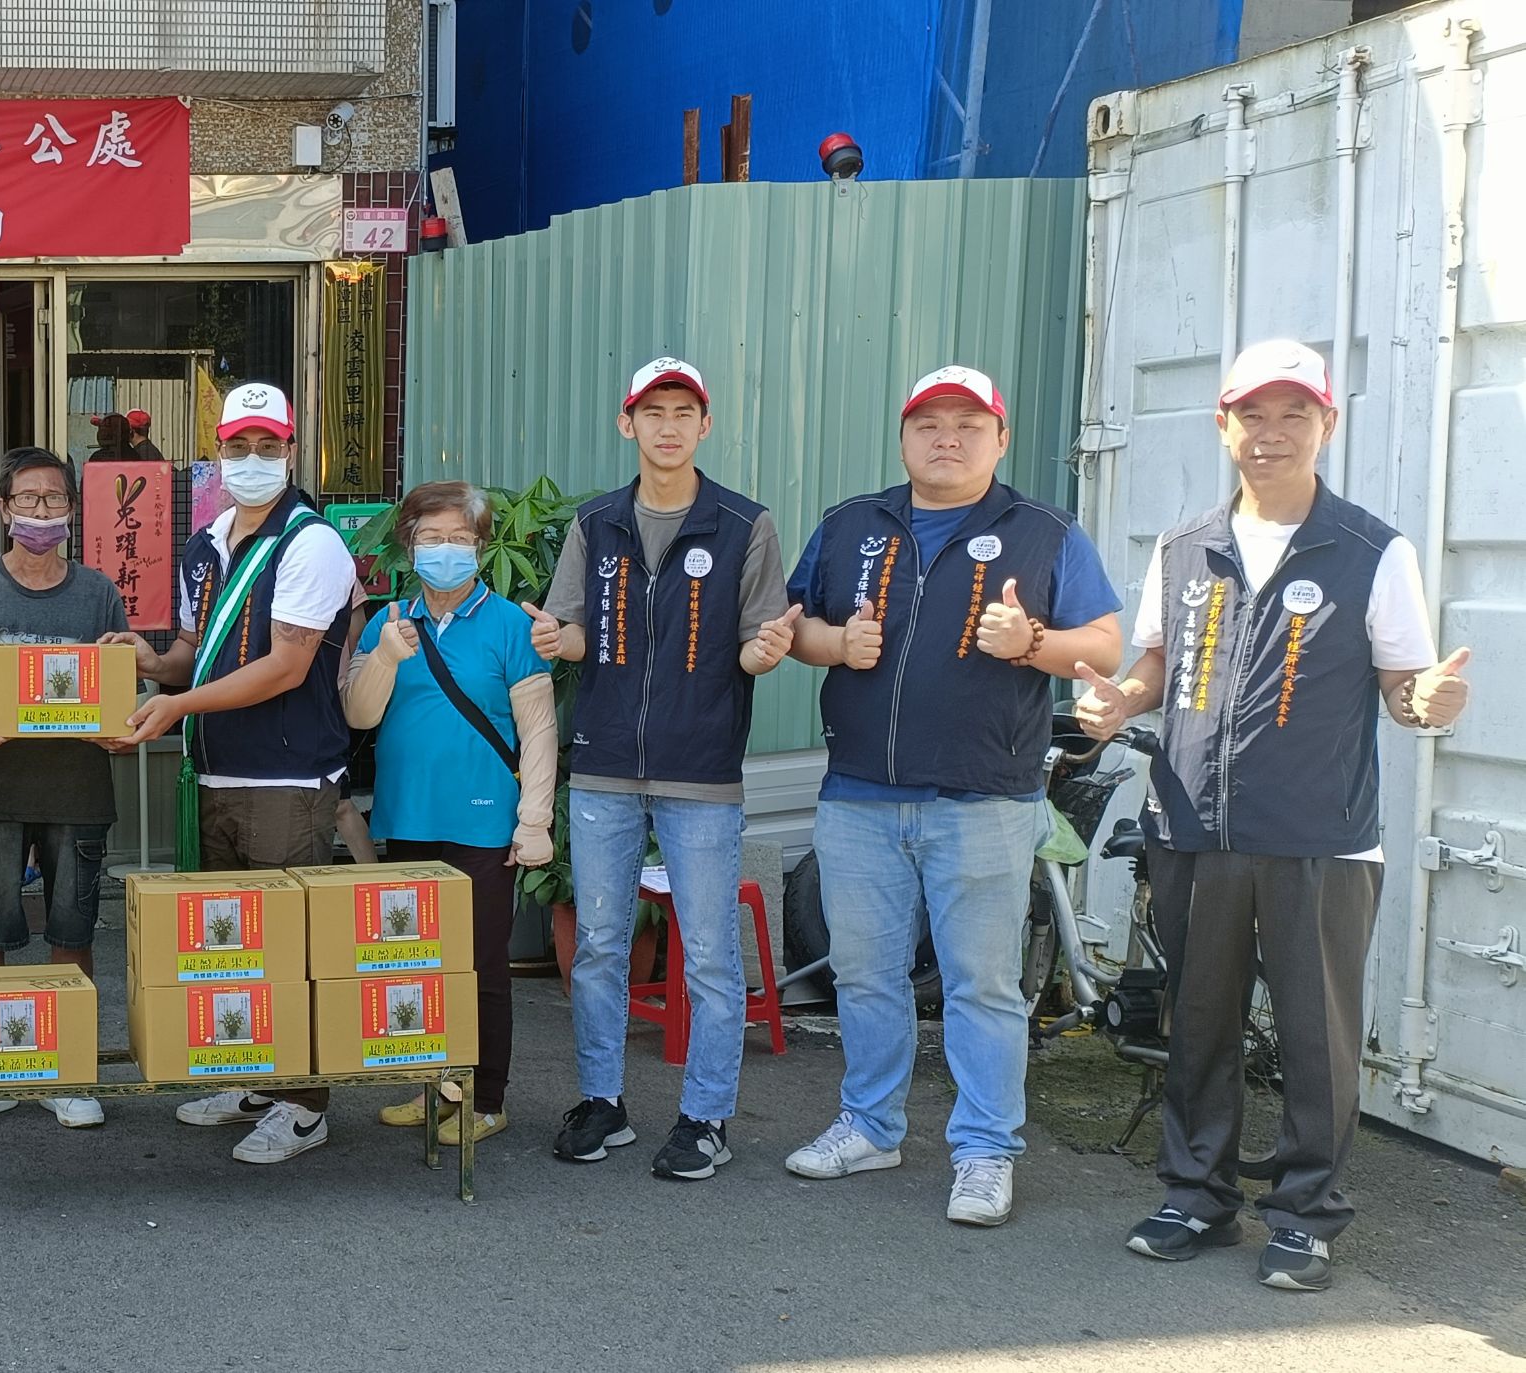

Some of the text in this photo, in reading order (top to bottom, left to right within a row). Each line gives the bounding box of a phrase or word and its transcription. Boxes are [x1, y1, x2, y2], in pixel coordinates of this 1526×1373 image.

[363, 227, 394, 249] 42
[342, 329, 365, 486] 凌雲里辦公處
[854, 559, 874, 608] 副主任張
